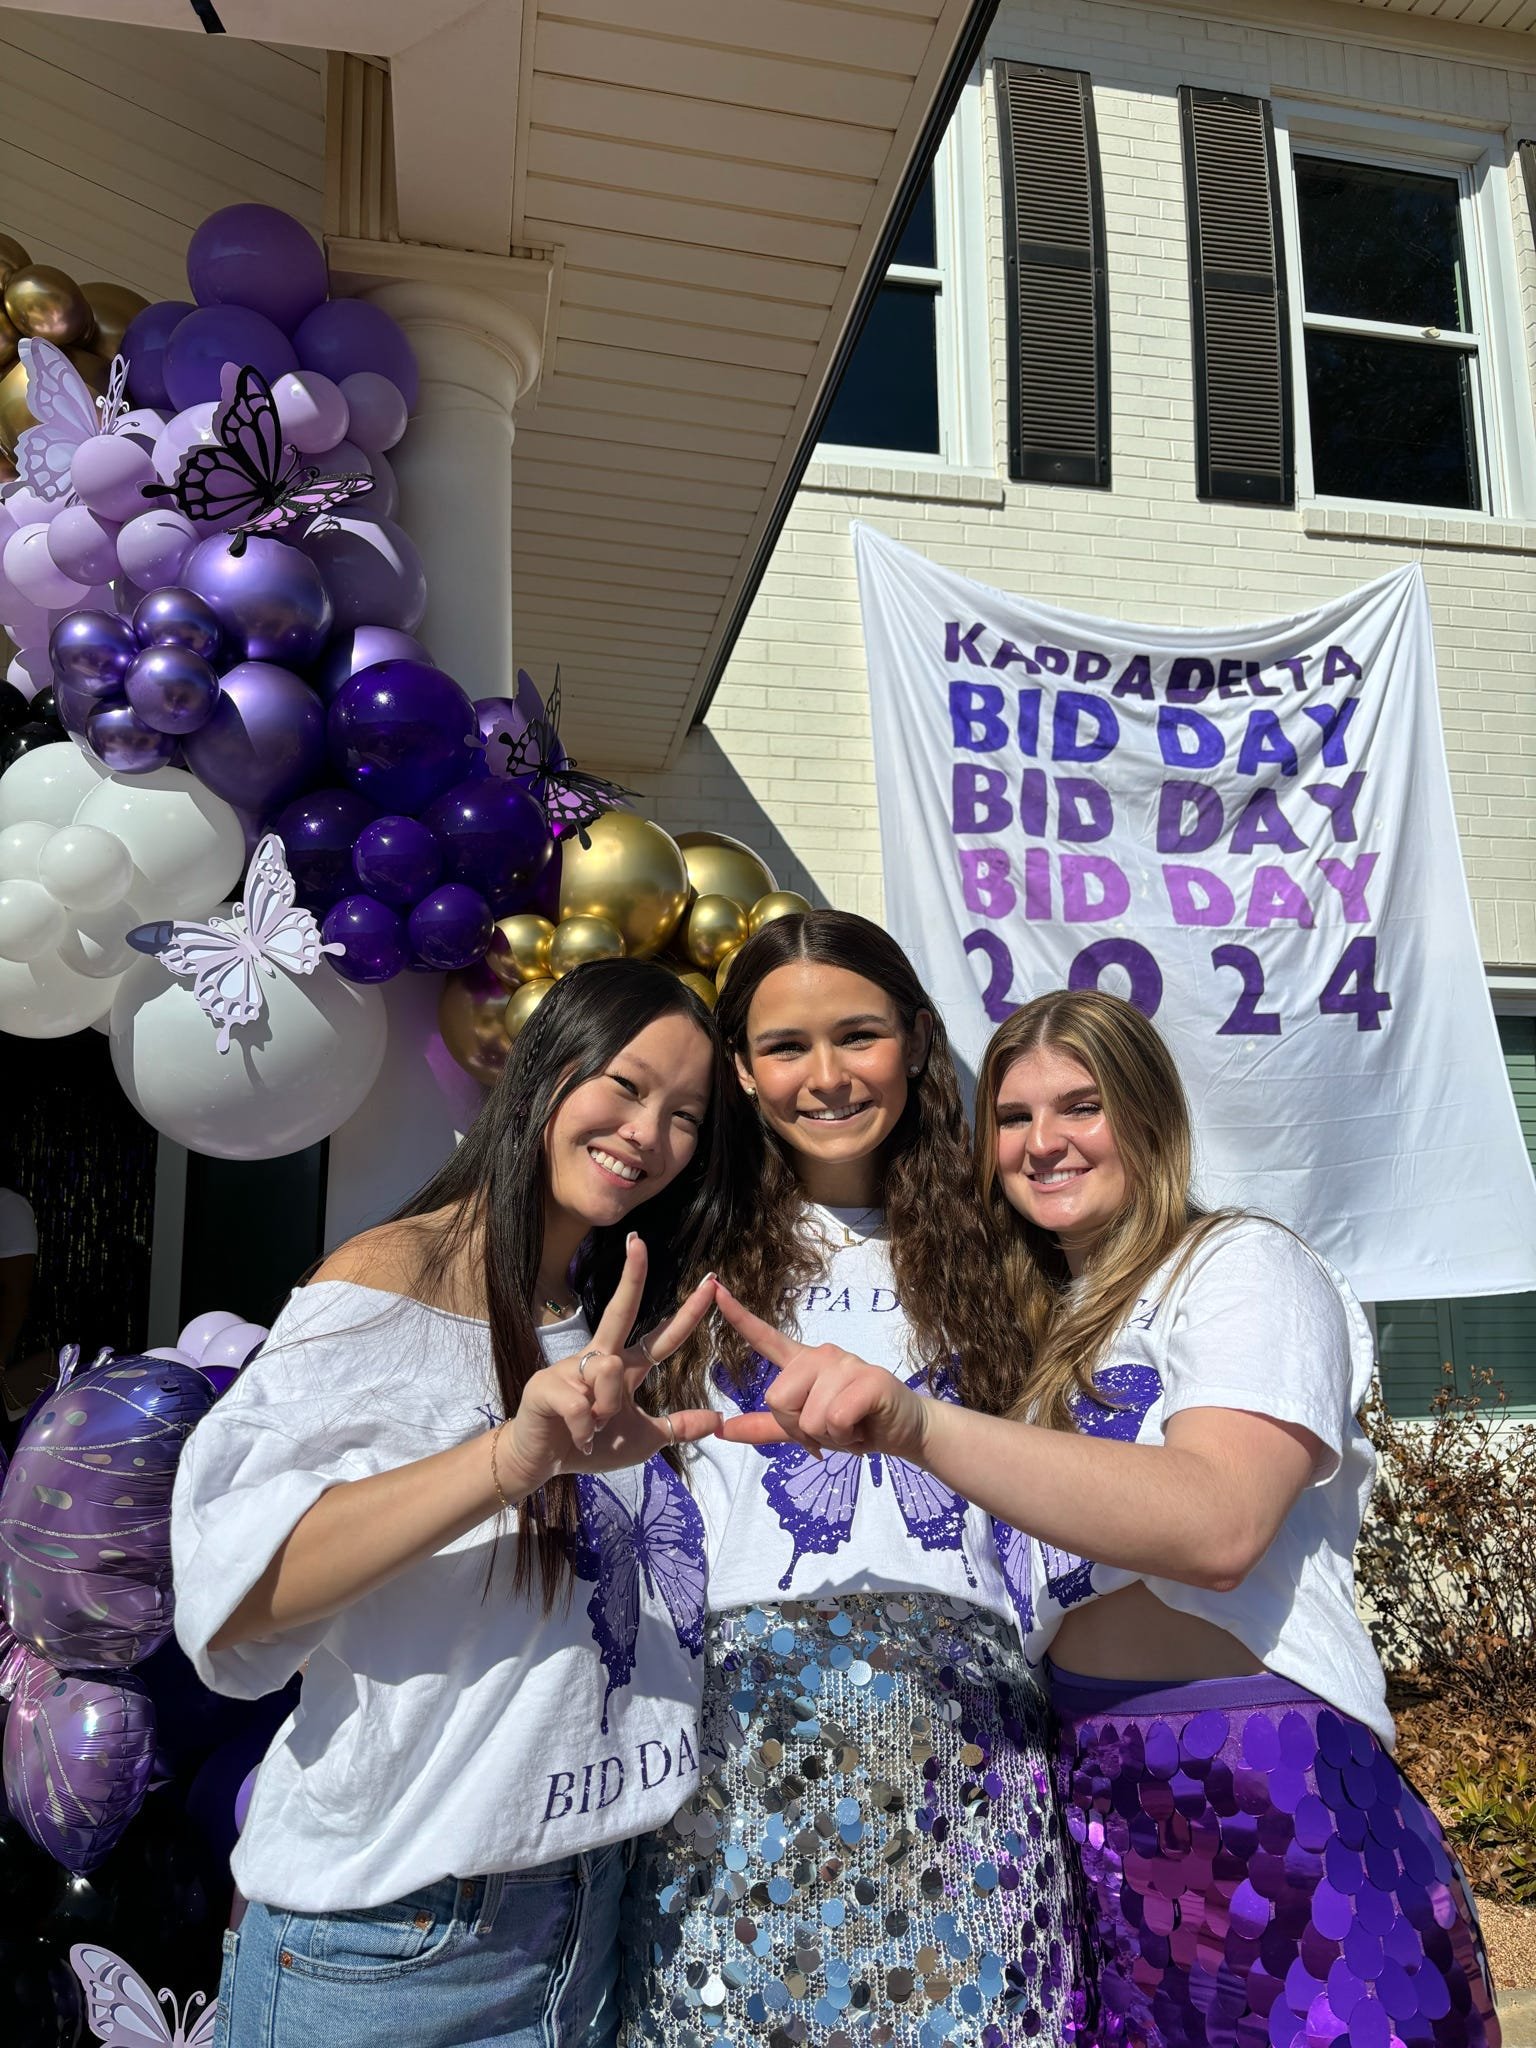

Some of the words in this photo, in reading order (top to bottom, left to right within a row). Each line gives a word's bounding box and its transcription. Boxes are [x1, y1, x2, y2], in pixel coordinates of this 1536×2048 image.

[944, 621, 1155, 701] KAPPA
[1164, 645, 1362, 705] DELTA
[948, 680, 1120, 763] BID
[1156, 697, 1361, 777] DAY
[951, 762, 1115, 843] BID
[1156, 770, 1368, 855] DAY
[958, 847, 1132, 924] BID
[1161, 851, 1382, 930] DAY
[774, 1286, 851, 1312] PPA
[540, 1756, 625, 1824] BID
[635, 1718, 699, 1792] DA
